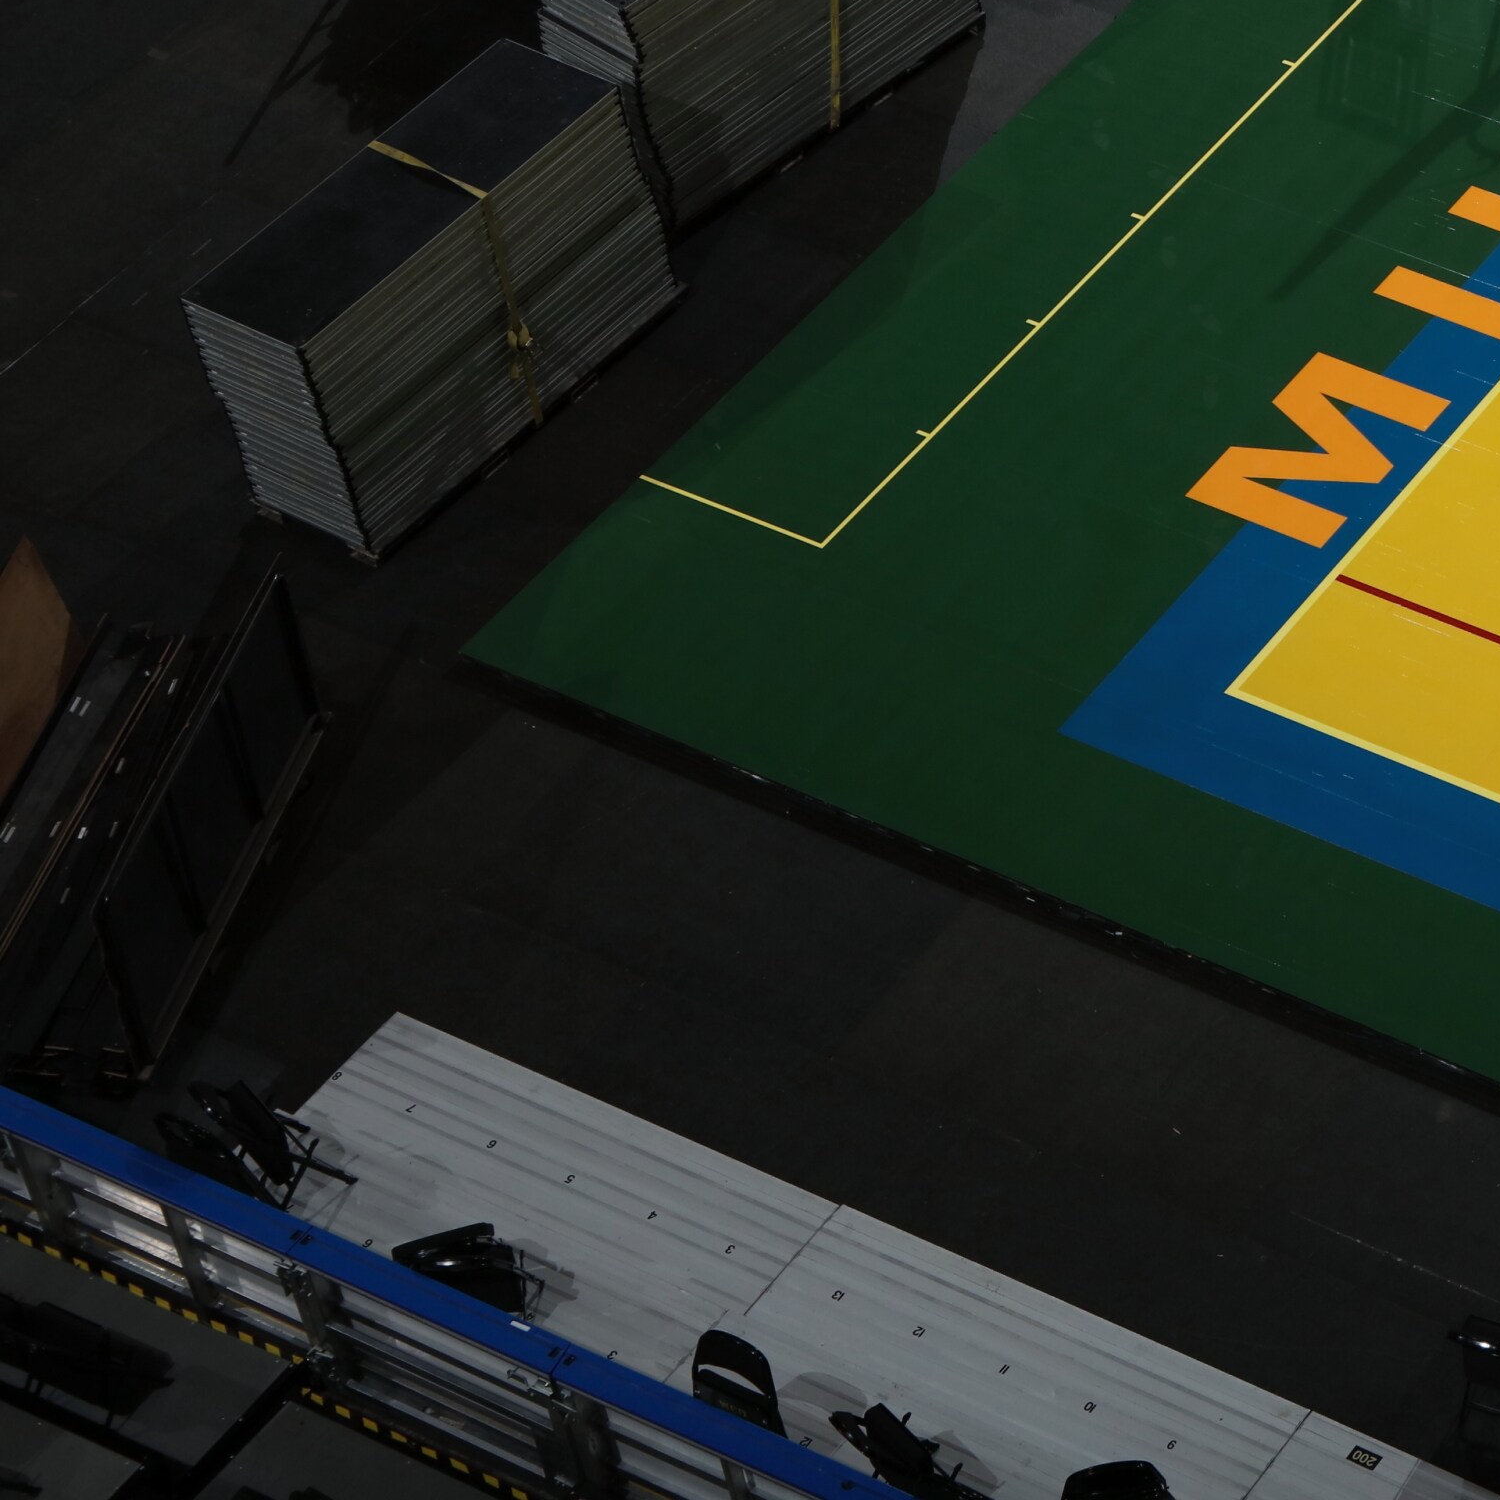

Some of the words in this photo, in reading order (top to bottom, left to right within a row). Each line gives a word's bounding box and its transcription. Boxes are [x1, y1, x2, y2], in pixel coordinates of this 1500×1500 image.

[331, 1071, 342, 1081] 8
[405, 1103, 417, 1113] 7
[564, 1174, 575, 1184] 5
[647, 1210, 657, 1220] 4
[725, 1244, 735, 1255] 3
[831, 1290, 845, 1301] 13
[912, 1326, 926, 1338] 12
[607, 1350, 618, 1360] 3
[999, 1364, 1010, 1375] 11
[1084, 1401, 1097, 1413] 10
[800, 1436, 812, 1448] 12
[1351, 1449, 1378, 1467] 200
